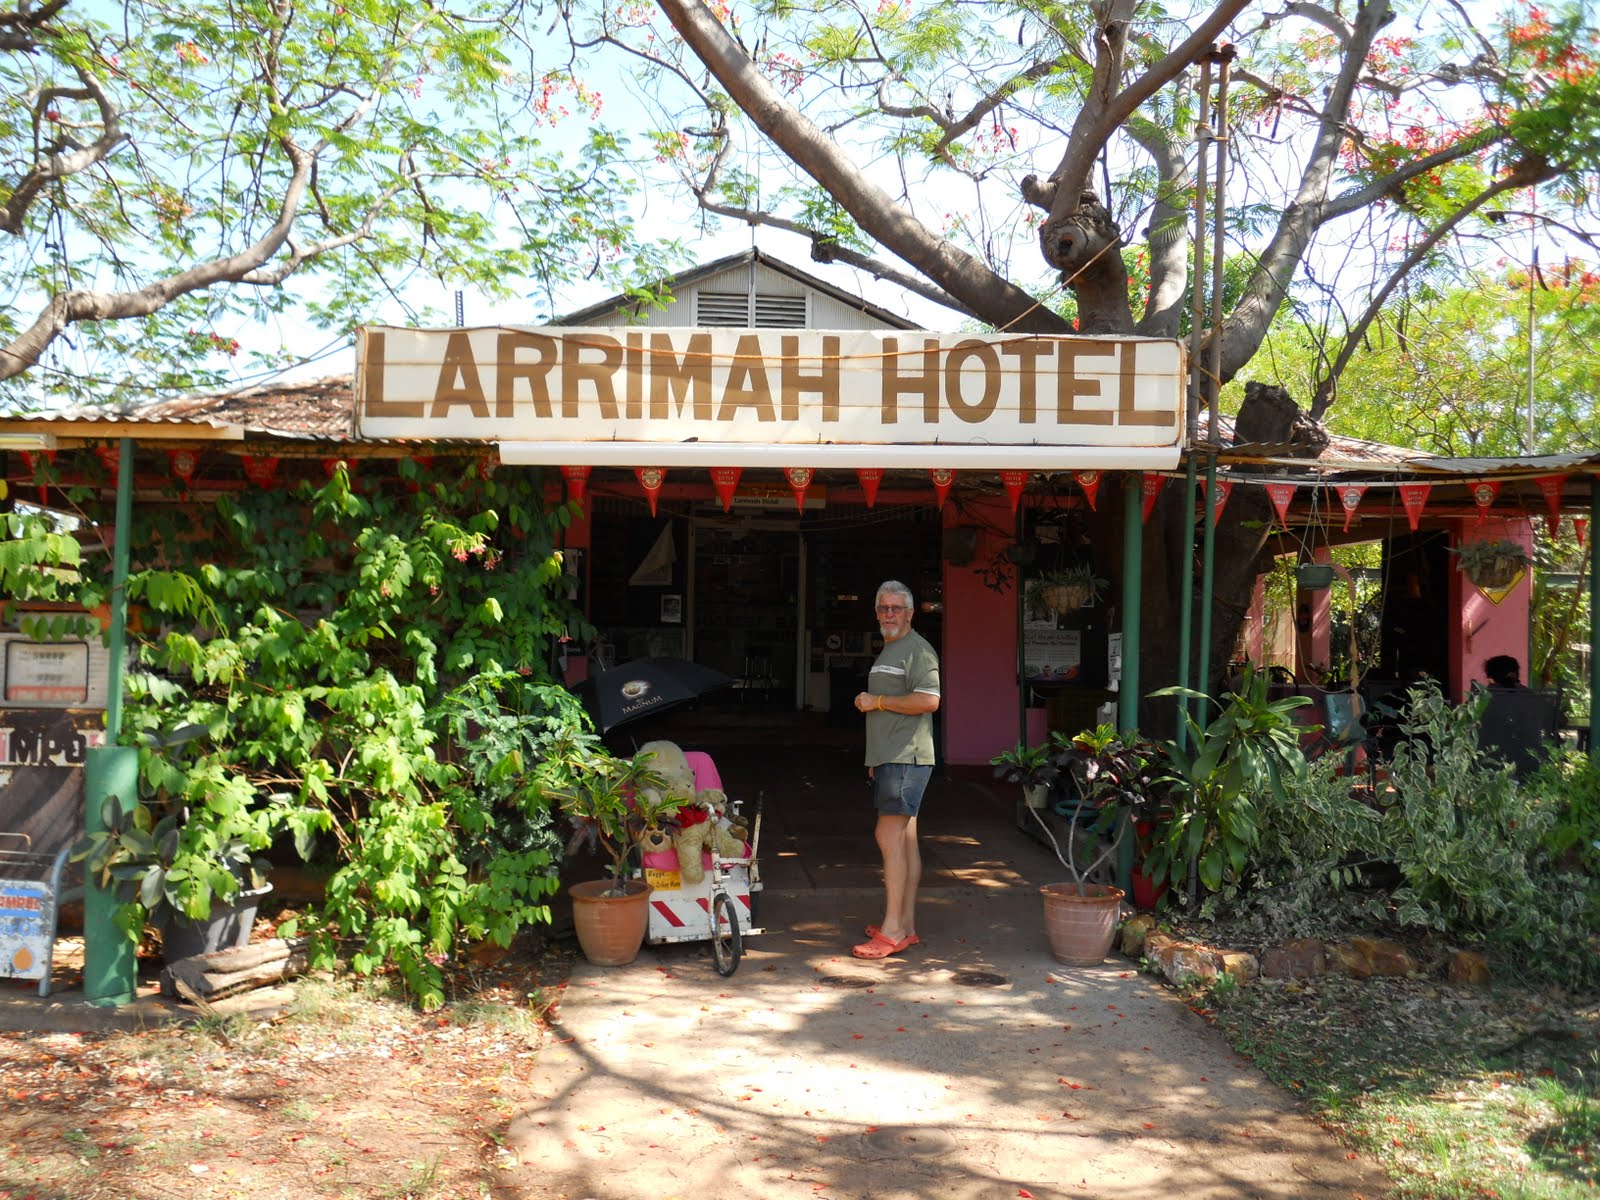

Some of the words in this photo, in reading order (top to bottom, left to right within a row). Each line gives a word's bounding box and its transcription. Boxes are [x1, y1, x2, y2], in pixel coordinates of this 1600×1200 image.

[365, 332, 840, 423] LARRIMAH
[881, 337, 1176, 426] HOTEL
[622, 695, 663, 714] MAGNUM
